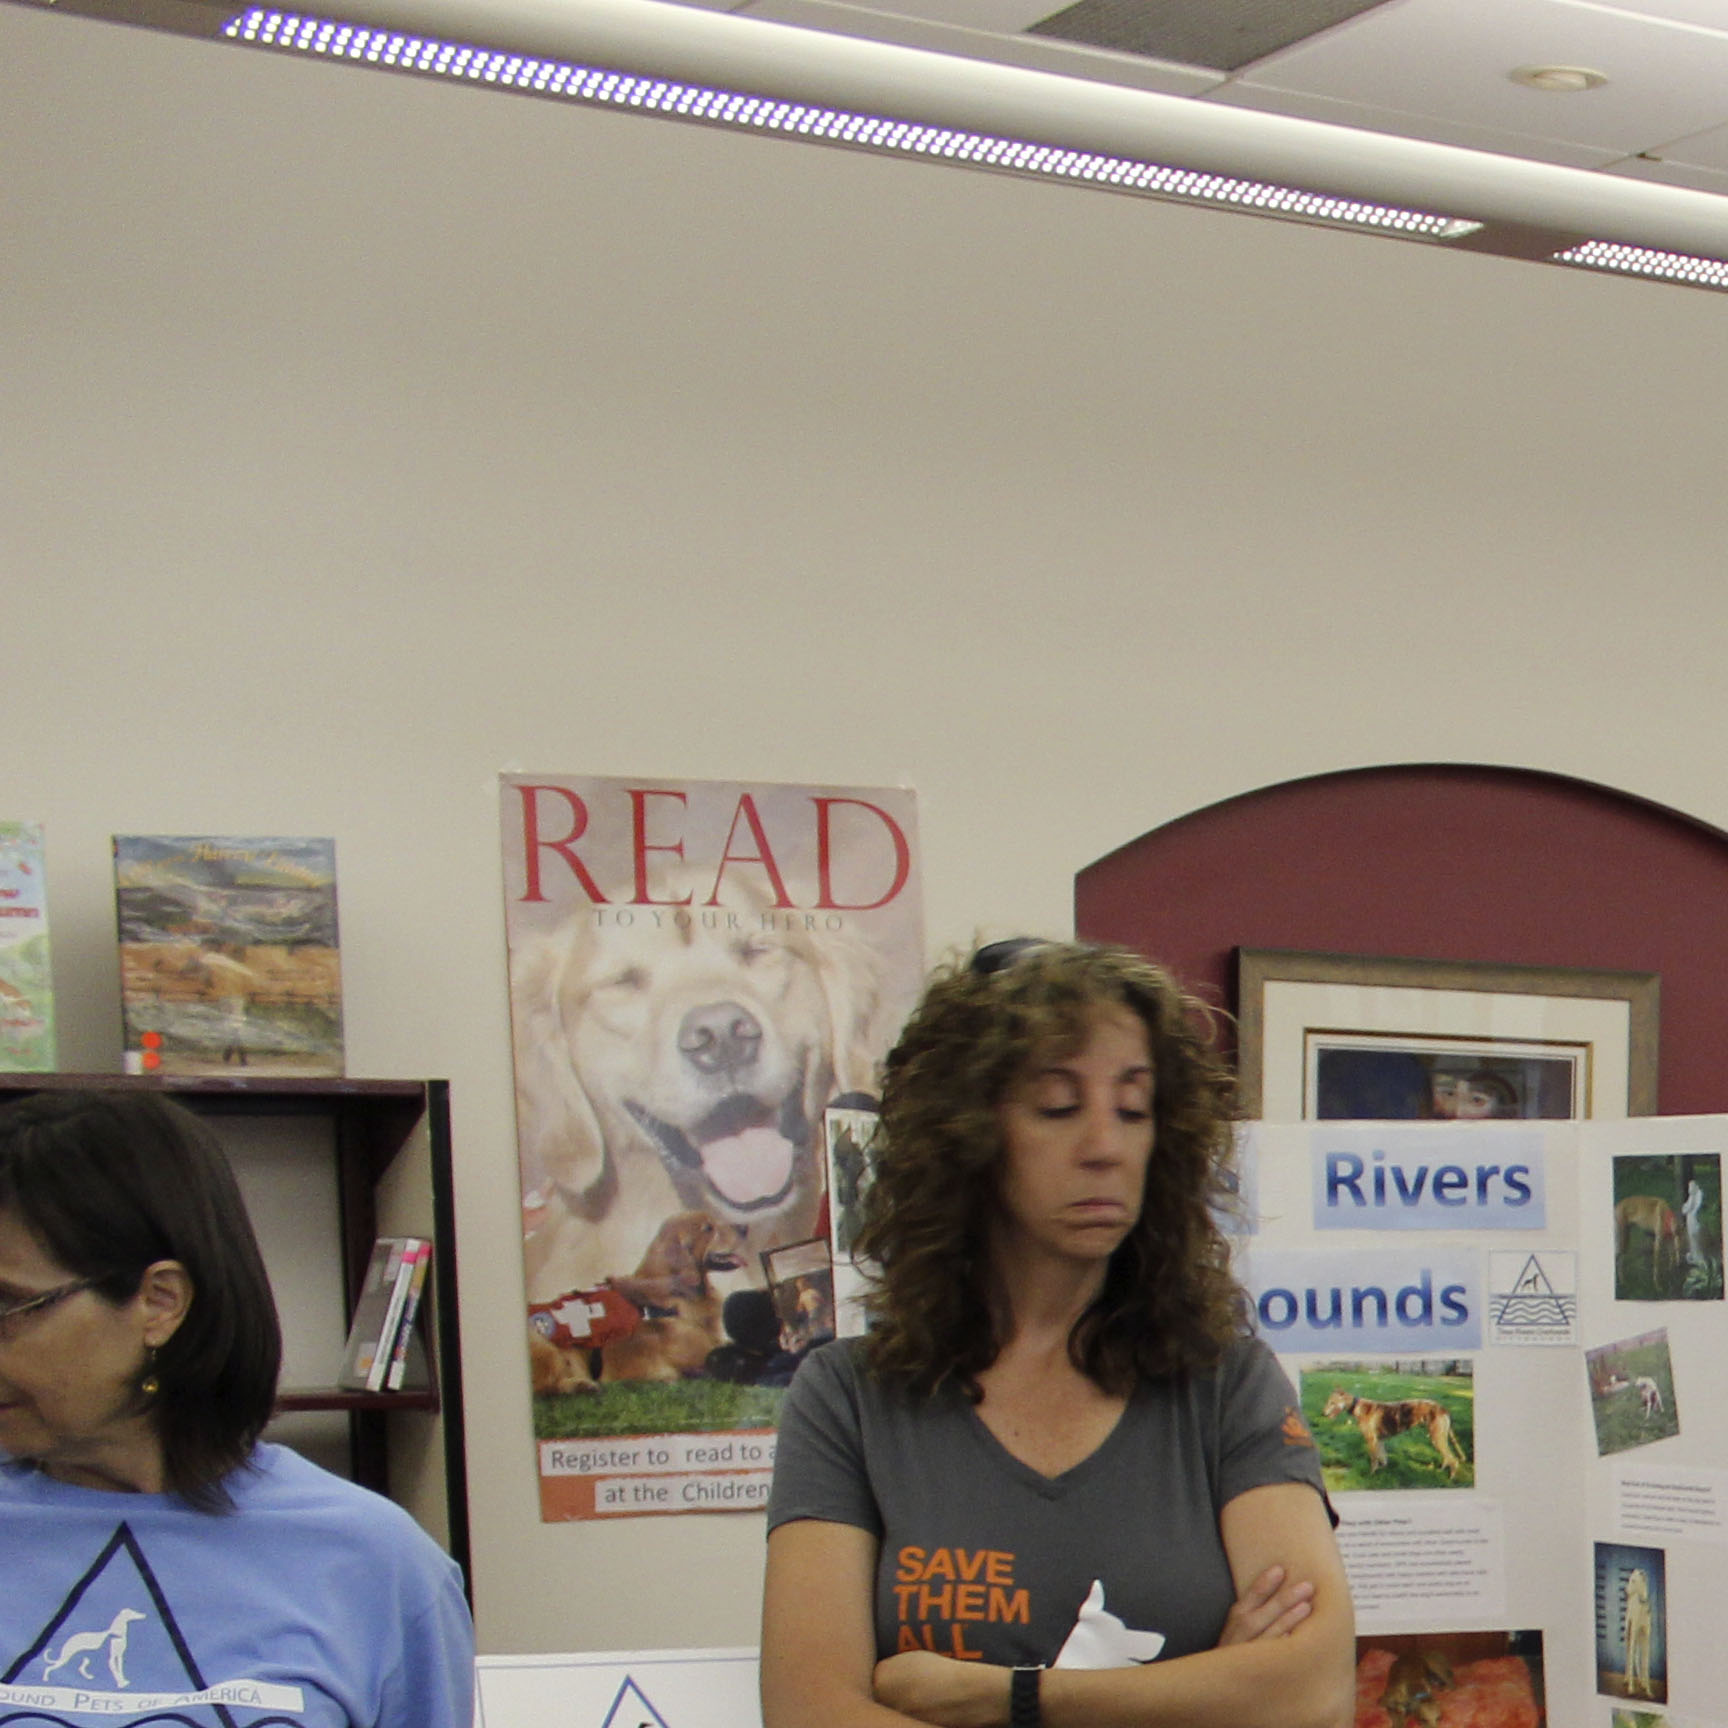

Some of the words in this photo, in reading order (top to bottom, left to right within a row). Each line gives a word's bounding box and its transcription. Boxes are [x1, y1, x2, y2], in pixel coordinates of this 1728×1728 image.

[511, 784, 910, 911] READ
[592, 909, 635, 928] TO
[650, 911, 742, 930] YOUR
[760, 912, 844, 931] HERO
[1326, 1150, 1532, 1207] Rivers
[552, 1449, 640, 1472] Register
[648, 1449, 670, 1466] to
[685, 1443, 733, 1463] read
[741, 1445, 762, 1460] to
[605, 1486, 626, 1503] at
[634, 1484, 668, 1502] the
[682, 1481, 770, 1502] Children
[896, 1545, 1016, 1586] SAVE
[892, 1583, 1031, 1625] THEM
[898, 1623, 984, 1660] ALL
[74, 1692, 125, 1712] PETS
[174, 1686, 263, 1705] AMERICA
